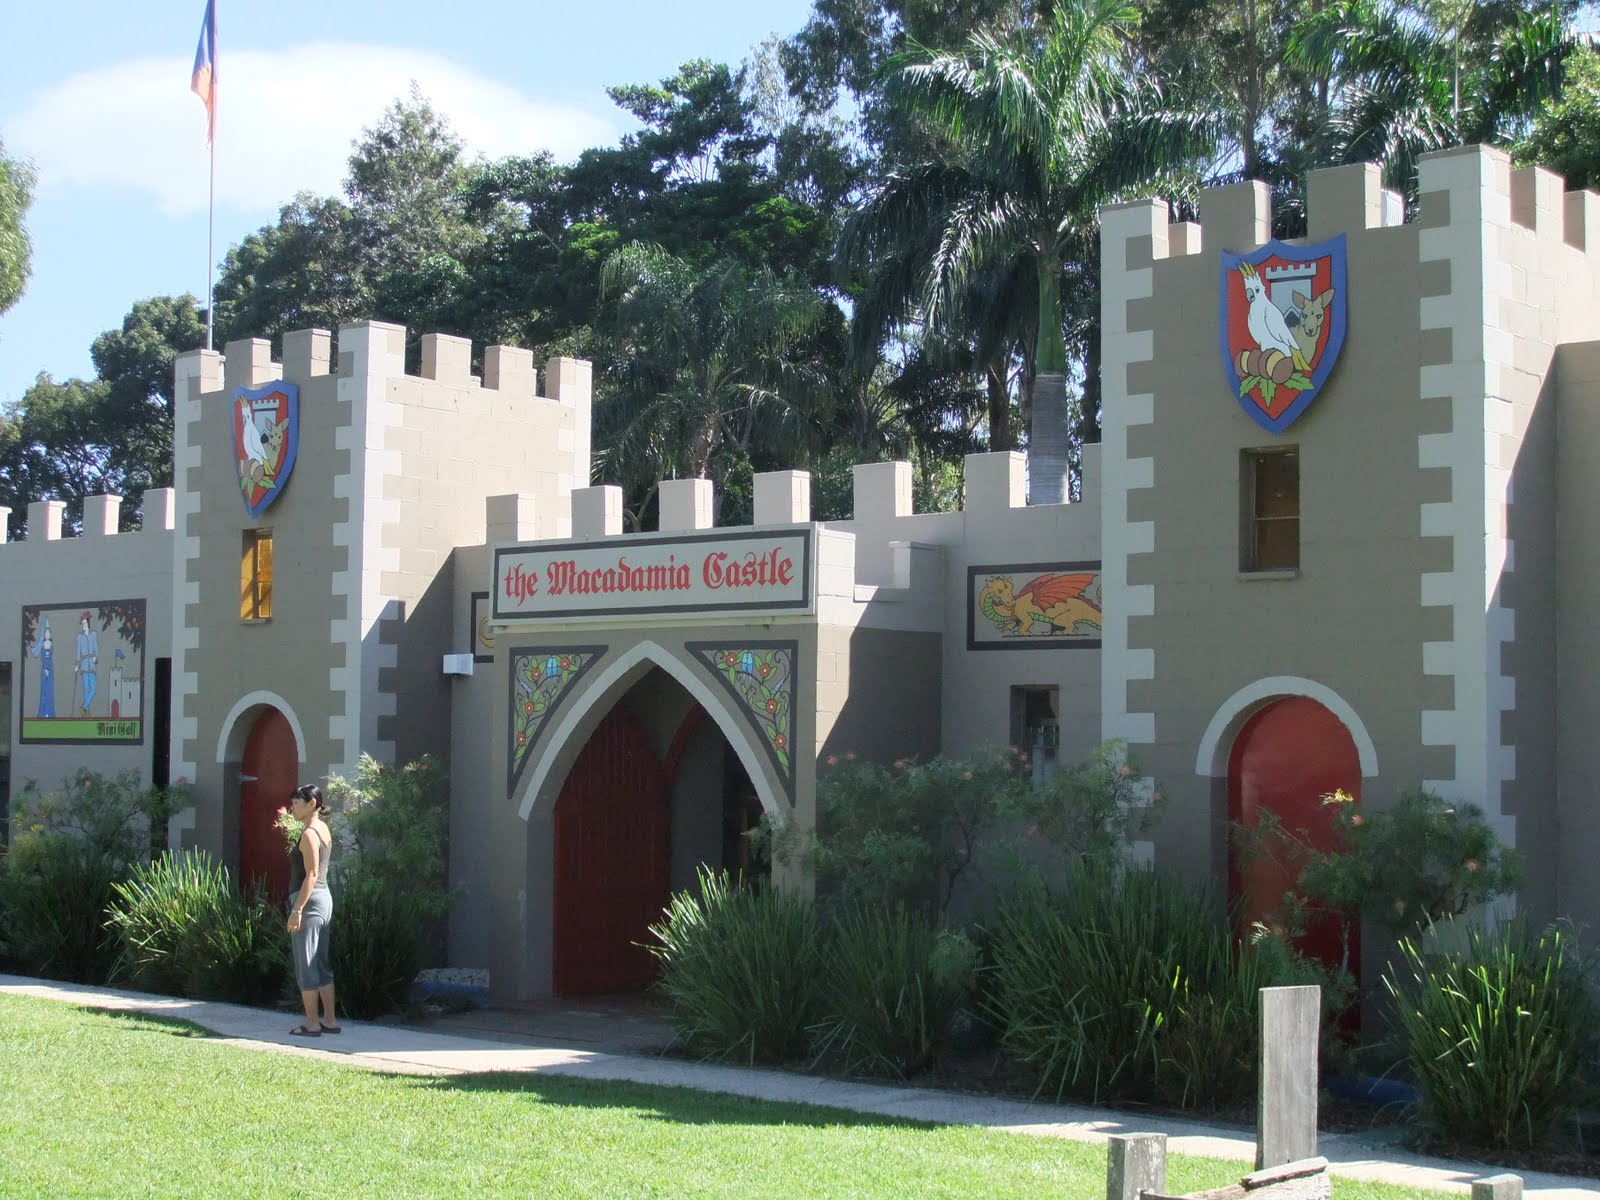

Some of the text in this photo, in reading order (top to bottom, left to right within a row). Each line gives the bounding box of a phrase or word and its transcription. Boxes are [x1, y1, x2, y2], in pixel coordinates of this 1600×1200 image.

[504, 546, 794, 608] the Macadamia Castle
